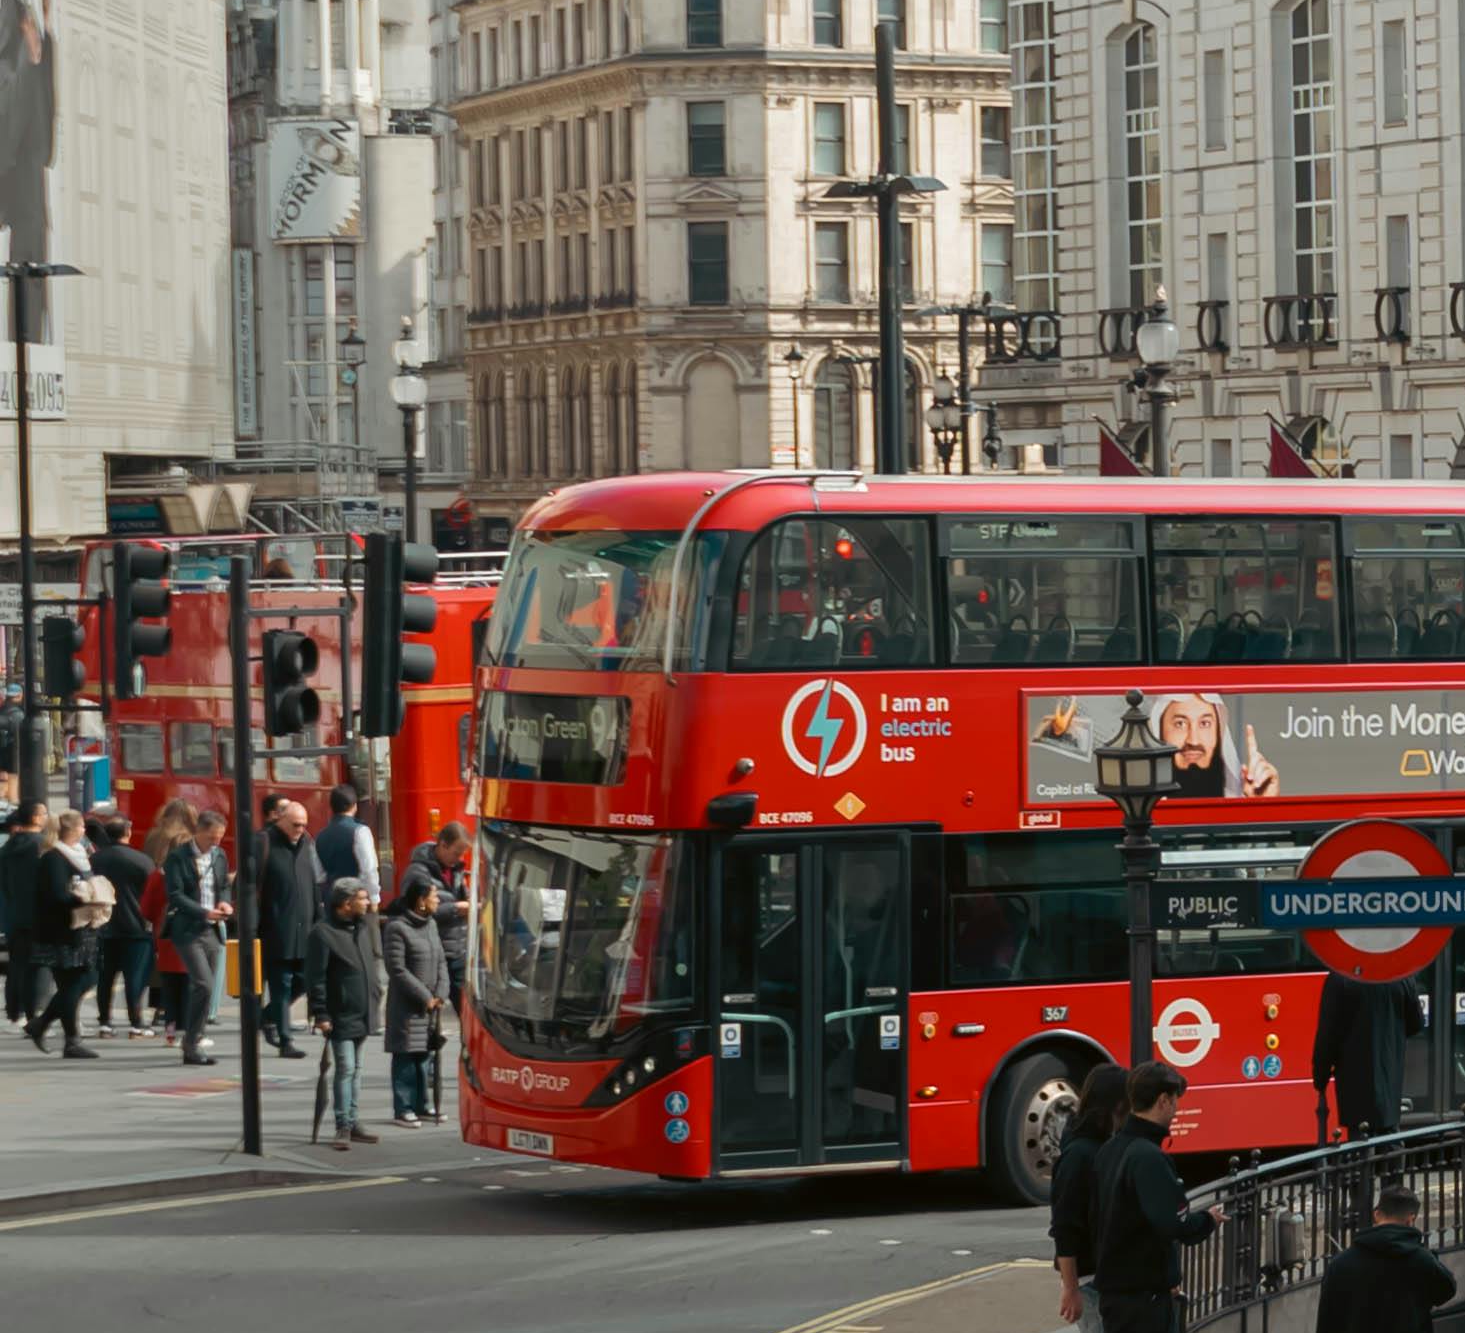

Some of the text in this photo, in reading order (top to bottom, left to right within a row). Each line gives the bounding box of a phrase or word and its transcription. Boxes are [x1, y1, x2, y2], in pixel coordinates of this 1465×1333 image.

[880, 693, 950, 713] I am an
[543, 712, 588, 740] Green
[880, 718, 952, 737] electric
[1280, 706, 1335, 739] Join
[1341, 705, 1384, 738] the
[880, 743, 916, 762] bus
[1036, 783, 1072, 799] Capital
[1072, 784, 1083, 796] at
[759, 811, 814, 824] BCE 47096
[1168, 896, 1239, 916] PUBLIC
[1045, 1006, 1069, 1023] 367
[1171, 1026, 1199, 1038] BUSES
[491, 1066, 571, 1092] RATP GROUP
